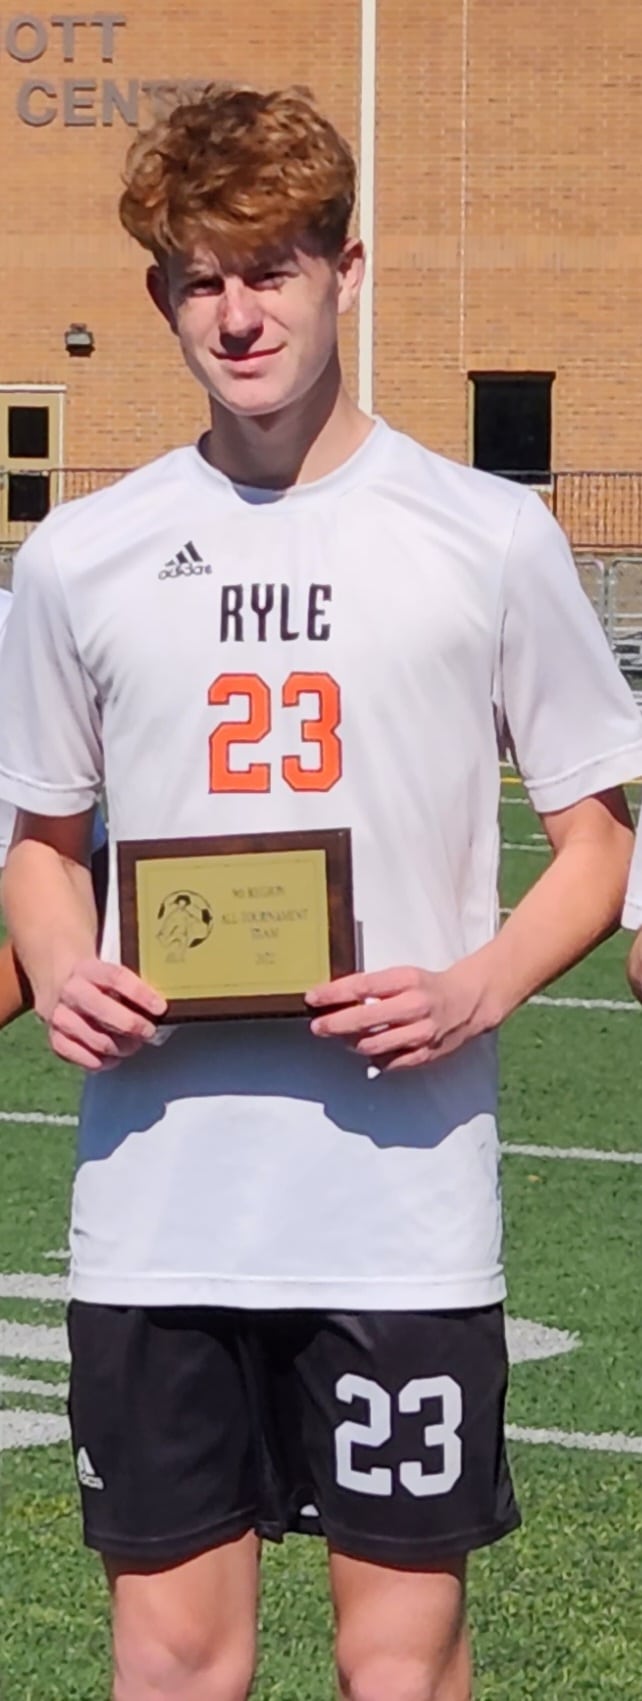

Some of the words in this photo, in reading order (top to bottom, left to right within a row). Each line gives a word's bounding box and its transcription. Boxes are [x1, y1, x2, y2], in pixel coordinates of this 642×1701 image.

[5, 14, 126, 63] OTT
[220, 583, 332, 642] RYLE
[208, 672, 342, 793] 23
[335, 1373, 463, 1497] 23
